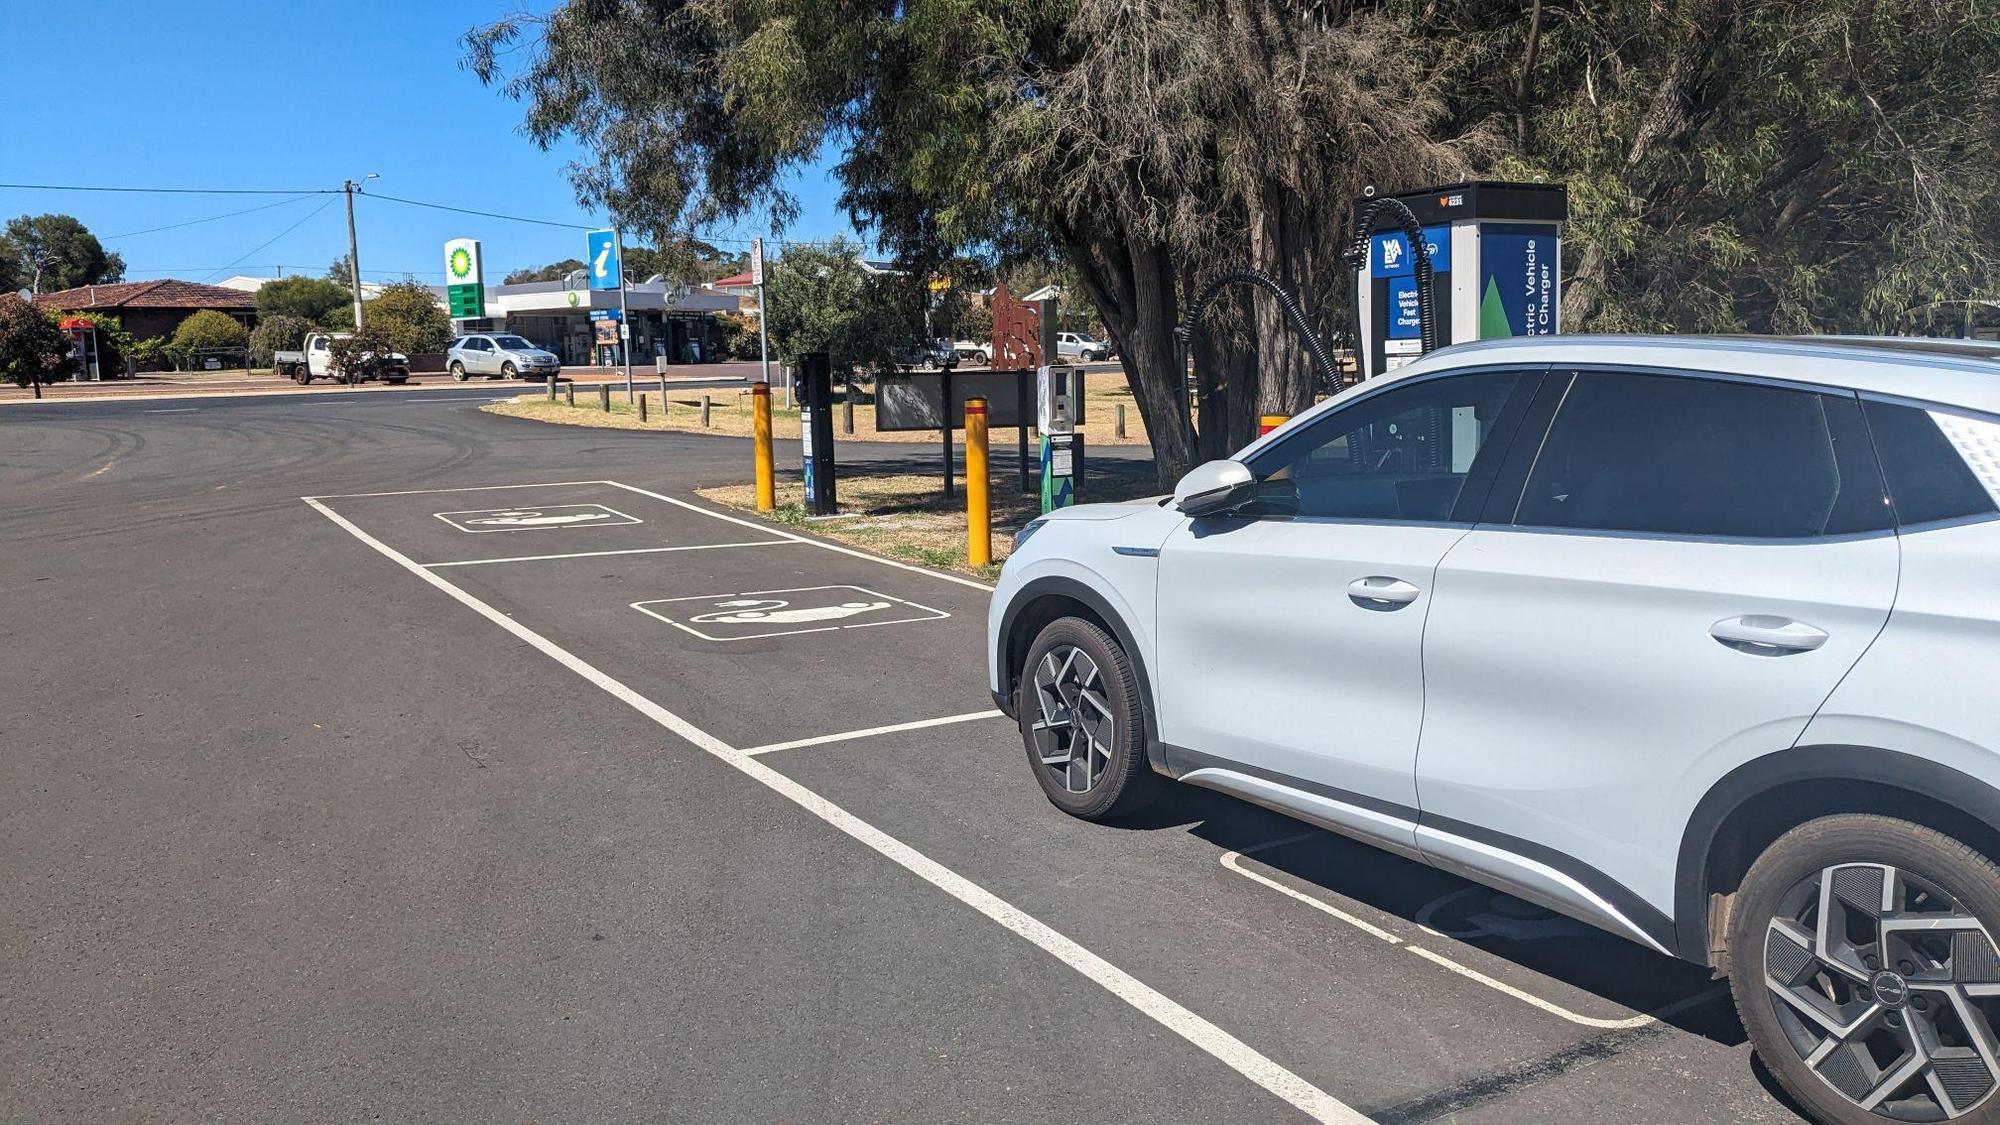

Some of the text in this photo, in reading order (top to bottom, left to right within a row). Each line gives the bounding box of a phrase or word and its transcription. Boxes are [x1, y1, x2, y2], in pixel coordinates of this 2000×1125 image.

[1403, 308, 1416, 317] Fast
[1526, 239, 1536, 336] ctric Vehicle
[1539, 263, 1551, 325] Charger
